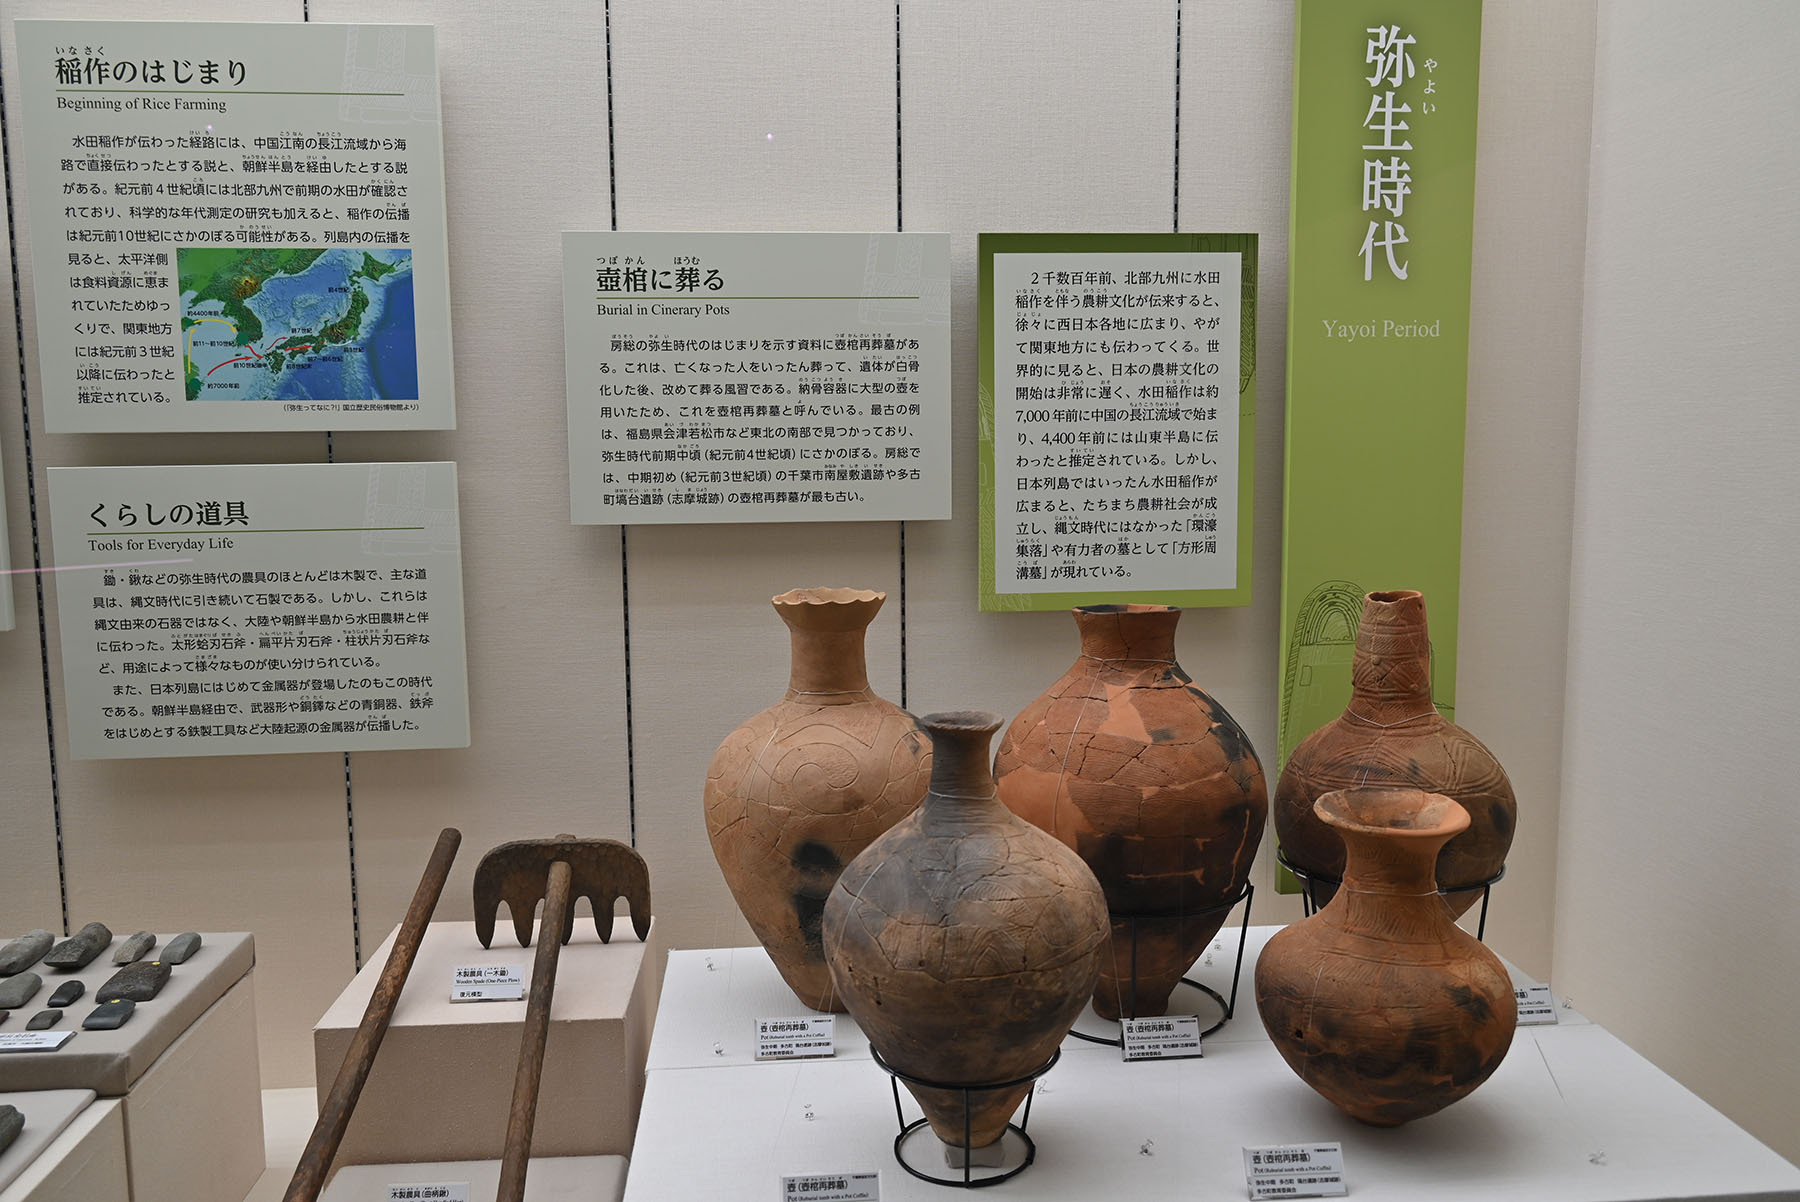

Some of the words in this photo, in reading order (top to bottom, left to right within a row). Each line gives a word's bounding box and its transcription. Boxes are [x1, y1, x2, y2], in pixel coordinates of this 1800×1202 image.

[56, 46, 105, 55] いなさく
[55, 58, 246, 86] 稲作のはじまり
[1422, 57, 1438, 115] やよい
[56, 97, 122, 112] Beginning
[125, 97, 139, 109] of
[142, 98, 170, 110] Rice
[174, 98, 227, 113] Farming
[72, 136, 407, 151] 水田稲作が伝わった経路には、中国江南の長江流域から海
[1358, 25, 1416, 281] 弥生時代
[61, 159, 408, 174] 路で直接伝わったとする説と、朝鮮半島を経由したとする説
[63, 182, 408, 197] がある。紀元前4世紀頃には北部九州で前期の水田が確認さ
[64, 206, 410, 221] れており、科学的な年代測定の研究も加えると、稲作の伝播
[66, 230, 410, 244] は紀元前10世紀にさかのぼる可能性がある。列島内の伝播を
[68, 253, 168, 266] 見ると、太平洋側
[596, 256, 646, 265] つぼかん
[673, 256, 701, 265] ほうむ
[70, 276, 169, 289] は食料資源に恵ま
[596, 266, 724, 292] 壺棺に葬る
[1031, 271, 1220, 285] 2千数百年前、北部九州に水田
[71, 300, 170, 312] れていたためゆっ
[1015, 294, 1221, 309] 稲作を伴う農耕文化が伝来すると、
[597, 304, 633, 315] Burial
[636, 304, 648, 315] in
[651, 304, 701, 318] Cinerary
[705, 304, 730, 315] Pots
[74, 323, 172, 335] くりで、関東地方
[1015, 317, 1220, 331] 徐々に西日本各地に広まり、やが
[1322, 320, 1376, 342] Yayoi
[1383, 320, 1440, 337] Period
[75, 346, 175, 358] には紀元前3世紀
[1016, 340, 1219, 355] て関東地方にも伝わってくる。世
[600, 360, 919, 374] る。これは、亡くなった人をいったん葬って、遺体が白骨
[1016, 362, 1219, 377] 界的に見ると、日本の農耕文化の
[76, 369, 175, 381] 以降に伝わったと
[78, 391, 171, 404] 推定されている。
[1016, 385, 1219, 400] 開始は非常に遅く、水田稲作は約
[602, 426, 915, 440] は、福島県会津若松市など東北の南部で見つかっており、
[1016, 453, 1218, 467] わったと推定されている。しかし、
[1017, 474, 1217, 490] 日本列島ではいったん水田稲作が
[1016, 497, 1217, 513] 広まると、たちまち農耕社会が成
[90, 500, 249, 527] くらしの道具
[1016, 518, 1217, 535] 立し、縄文時代にはなかった「環濠
[88, 539, 123, 551] Tools
[127, 539, 144, 550] for
[148, 538, 205, 553] Everyday
[209, 537, 234, 549] Life
[1016, 541, 1216, 557] 集落」や有力者の墓として「方形周
[1016, 565, 1132, 580] 溝墓」が現れている。
[93, 591, 428, 609] 具は、縄文時代に引き続いて石製である。しかし、これらは
[95, 612, 429, 631] 縄文由来の石器ではなく、大陸や朝鮮半島から水田農耕と伴
[99, 657, 381, 674] ど、用途によって様々なものが使い分けられている。
[112, 676, 433, 695] また、日本列島にはじめて金属器が登場したのもこの時代
[103, 720, 419, 739] をはじめとする鉄製工具など大陸起源の金属器が伝播した。
